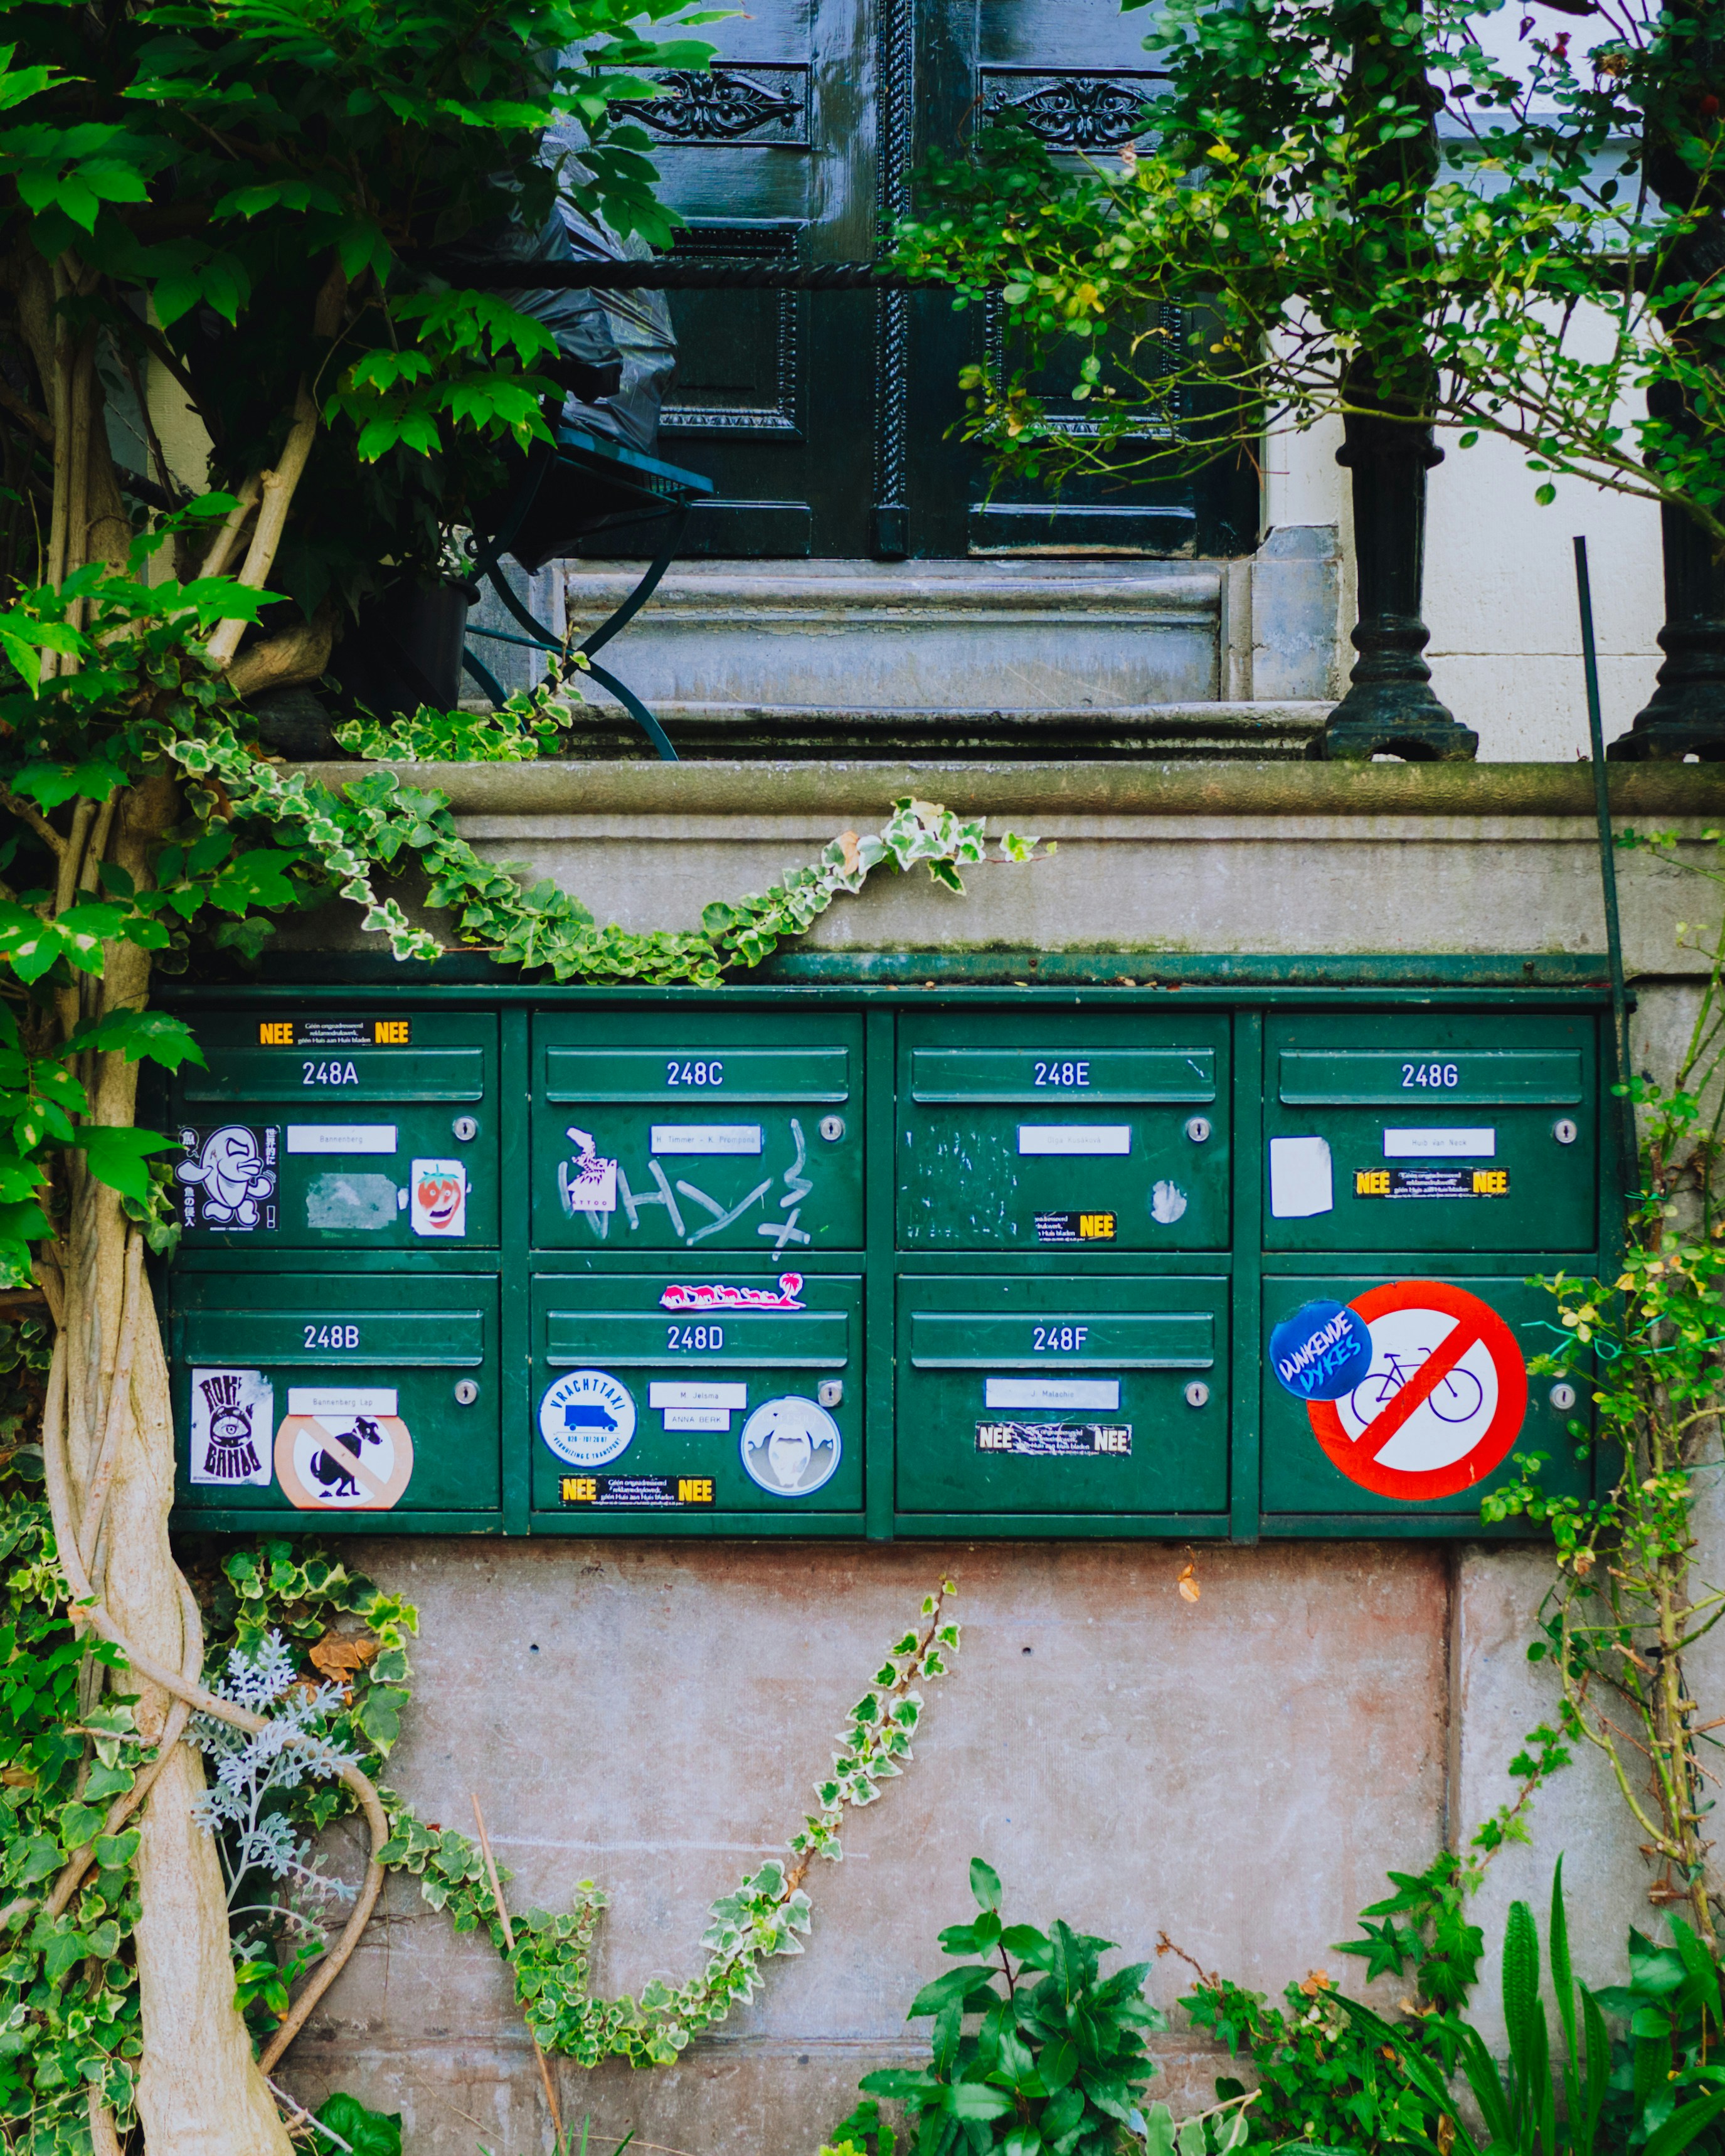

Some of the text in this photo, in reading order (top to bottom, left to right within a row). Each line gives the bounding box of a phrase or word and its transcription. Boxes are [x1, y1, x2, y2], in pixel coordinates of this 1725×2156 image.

[260, 1023, 294, 1044] NEE
[374, 1022, 408, 1043] NEE
[302, 1061, 359, 1085] 248A
[667, 1061, 723, 1085] 248C
[1034, 1062, 1090, 1085] 248E
[1402, 1064, 1458, 1087] 248G
[320, 1135, 363, 1144] Bannenberg
[1356, 1172, 1391, 1194] NEE
[1473, 1171, 1507, 1193] NEE
[1080, 1214, 1114, 1237] NEE
[304, 1325, 359, 1349] 248B
[667, 1325, 723, 1349] 248D
[1033, 1327, 1088, 1350] 248F
[1279, 1310, 1353, 1382] DUNKENDE
[1299, 1334, 1361, 1393] DYKES
[313, 1398, 356, 1407] Bannenberg
[550, 1378, 625, 1410] VRACHTTAXI
[554, 1437, 584, 1459] VERHUIZING
[592, 1438, 622, 1459] TRANSPORT
[979, 1426, 1013, 1448] NEE
[1094, 1430, 1127, 1452] NEE
[563, 1479, 597, 1500] NEE
[678, 1479, 713, 1502] NEE
